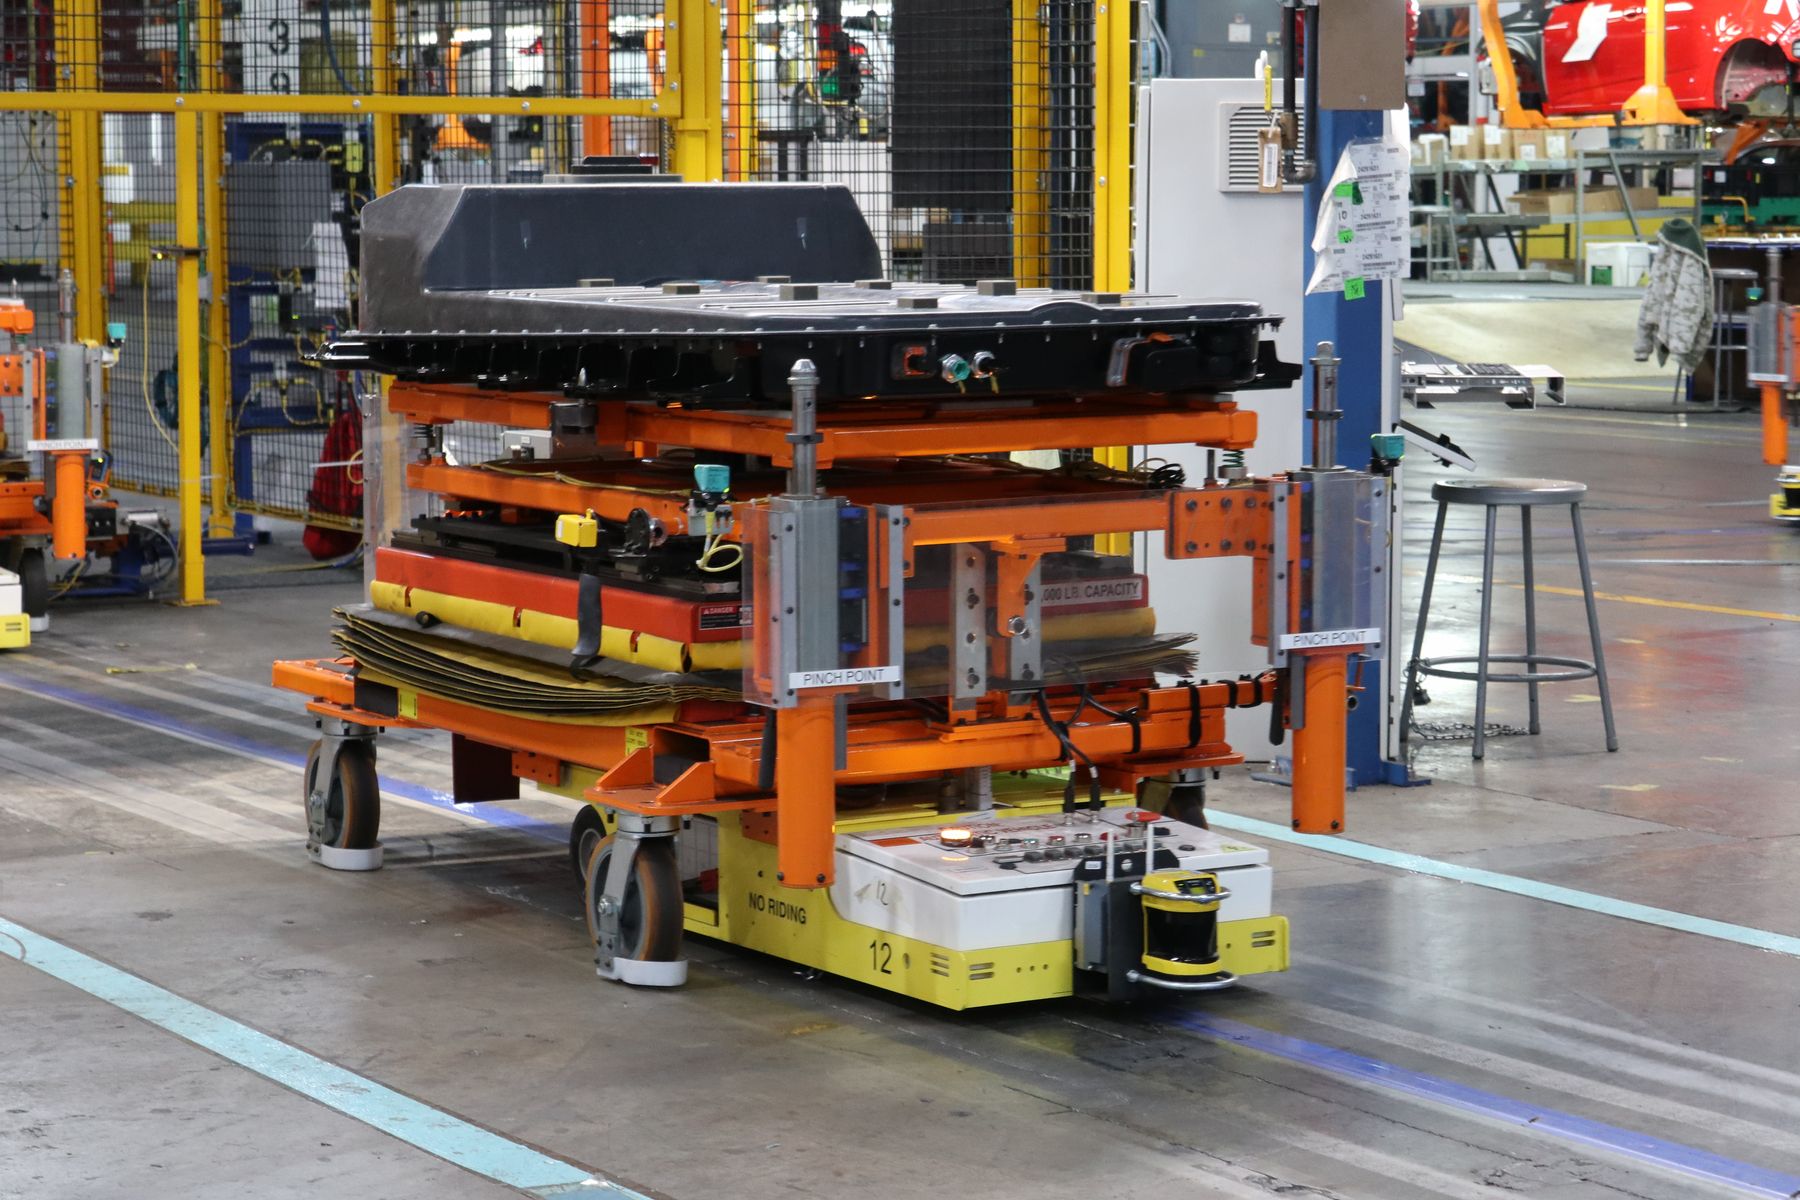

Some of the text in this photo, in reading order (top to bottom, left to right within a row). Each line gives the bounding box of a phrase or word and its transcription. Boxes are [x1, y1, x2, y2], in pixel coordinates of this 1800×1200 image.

[1084, 582, 1139, 598] CAPACITY
[1293, 630, 1367, 646] PINCH POINT
[803, 668, 884, 686] PINCH POINT
[876, 880, 889, 906] 12
[749, 891, 806, 925] NO RIDING
[869, 939, 893, 975] 12
